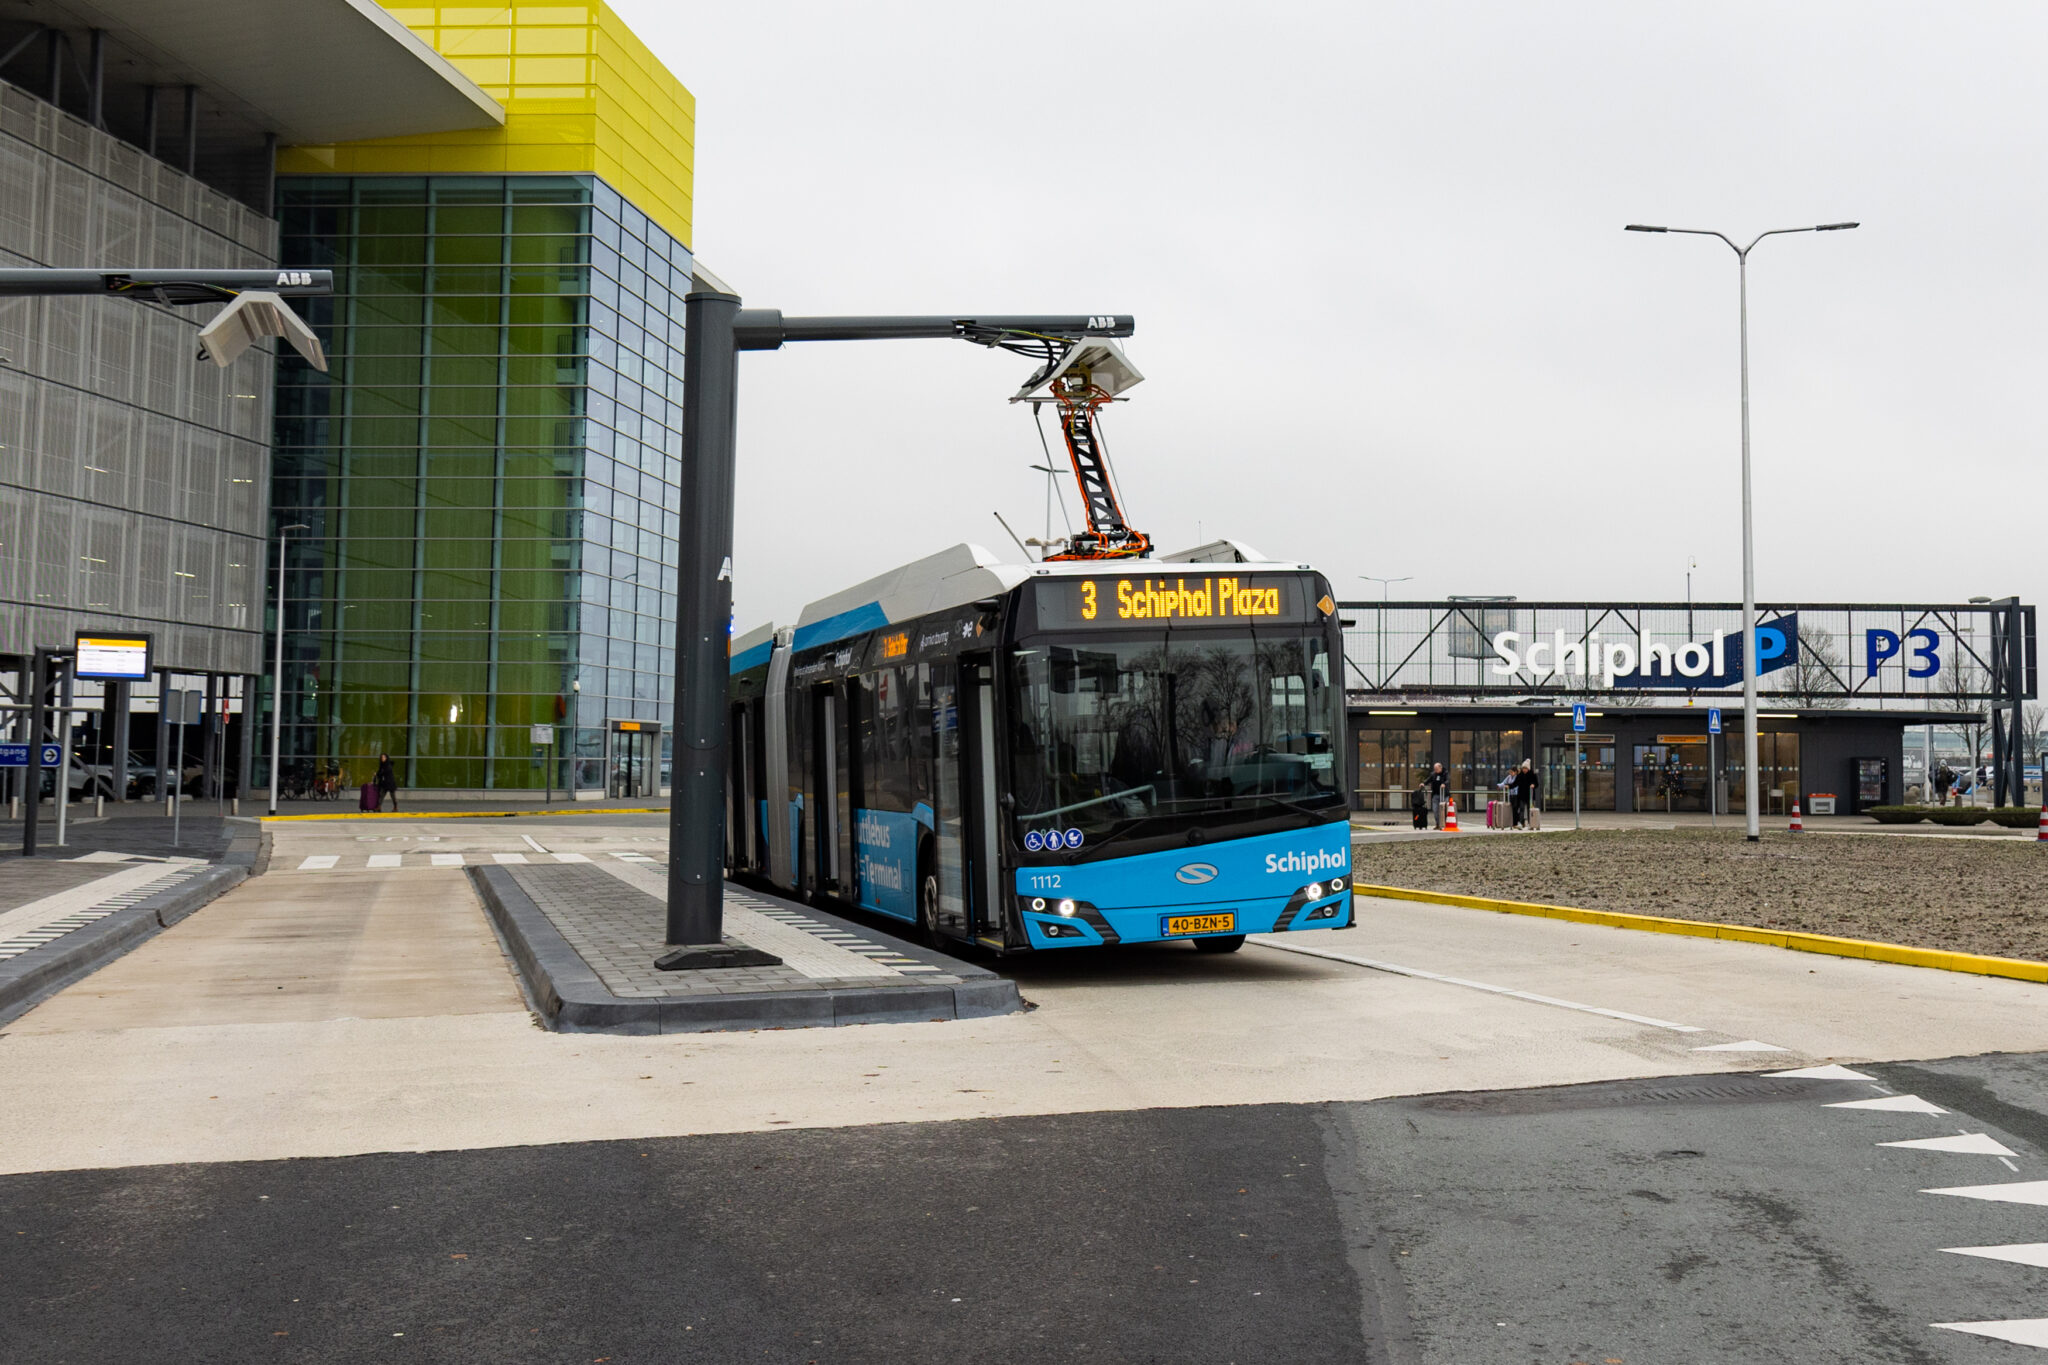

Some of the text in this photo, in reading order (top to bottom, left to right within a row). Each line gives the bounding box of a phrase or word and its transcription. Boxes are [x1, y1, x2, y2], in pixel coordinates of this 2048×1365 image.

[276, 272, 312, 285] ABB
[1087, 316, 1116, 329] ABB
[717, 556, 732, 582] A
[1081, 577, 1279, 619] 3 Schiphol Plaza
[1492, 627, 1787, 689] Schiphol P
[1866, 628, 1941, 678] P3
[0, 748, 27, 757] tgang
[858, 814, 890, 848] uttlebus
[864, 854, 902, 890] Terminal
[1265, 846, 1346, 875] Schiphol
[1030, 874, 1062, 889] 1112
[1172, 916, 1230, 930] 40-BZN-5
